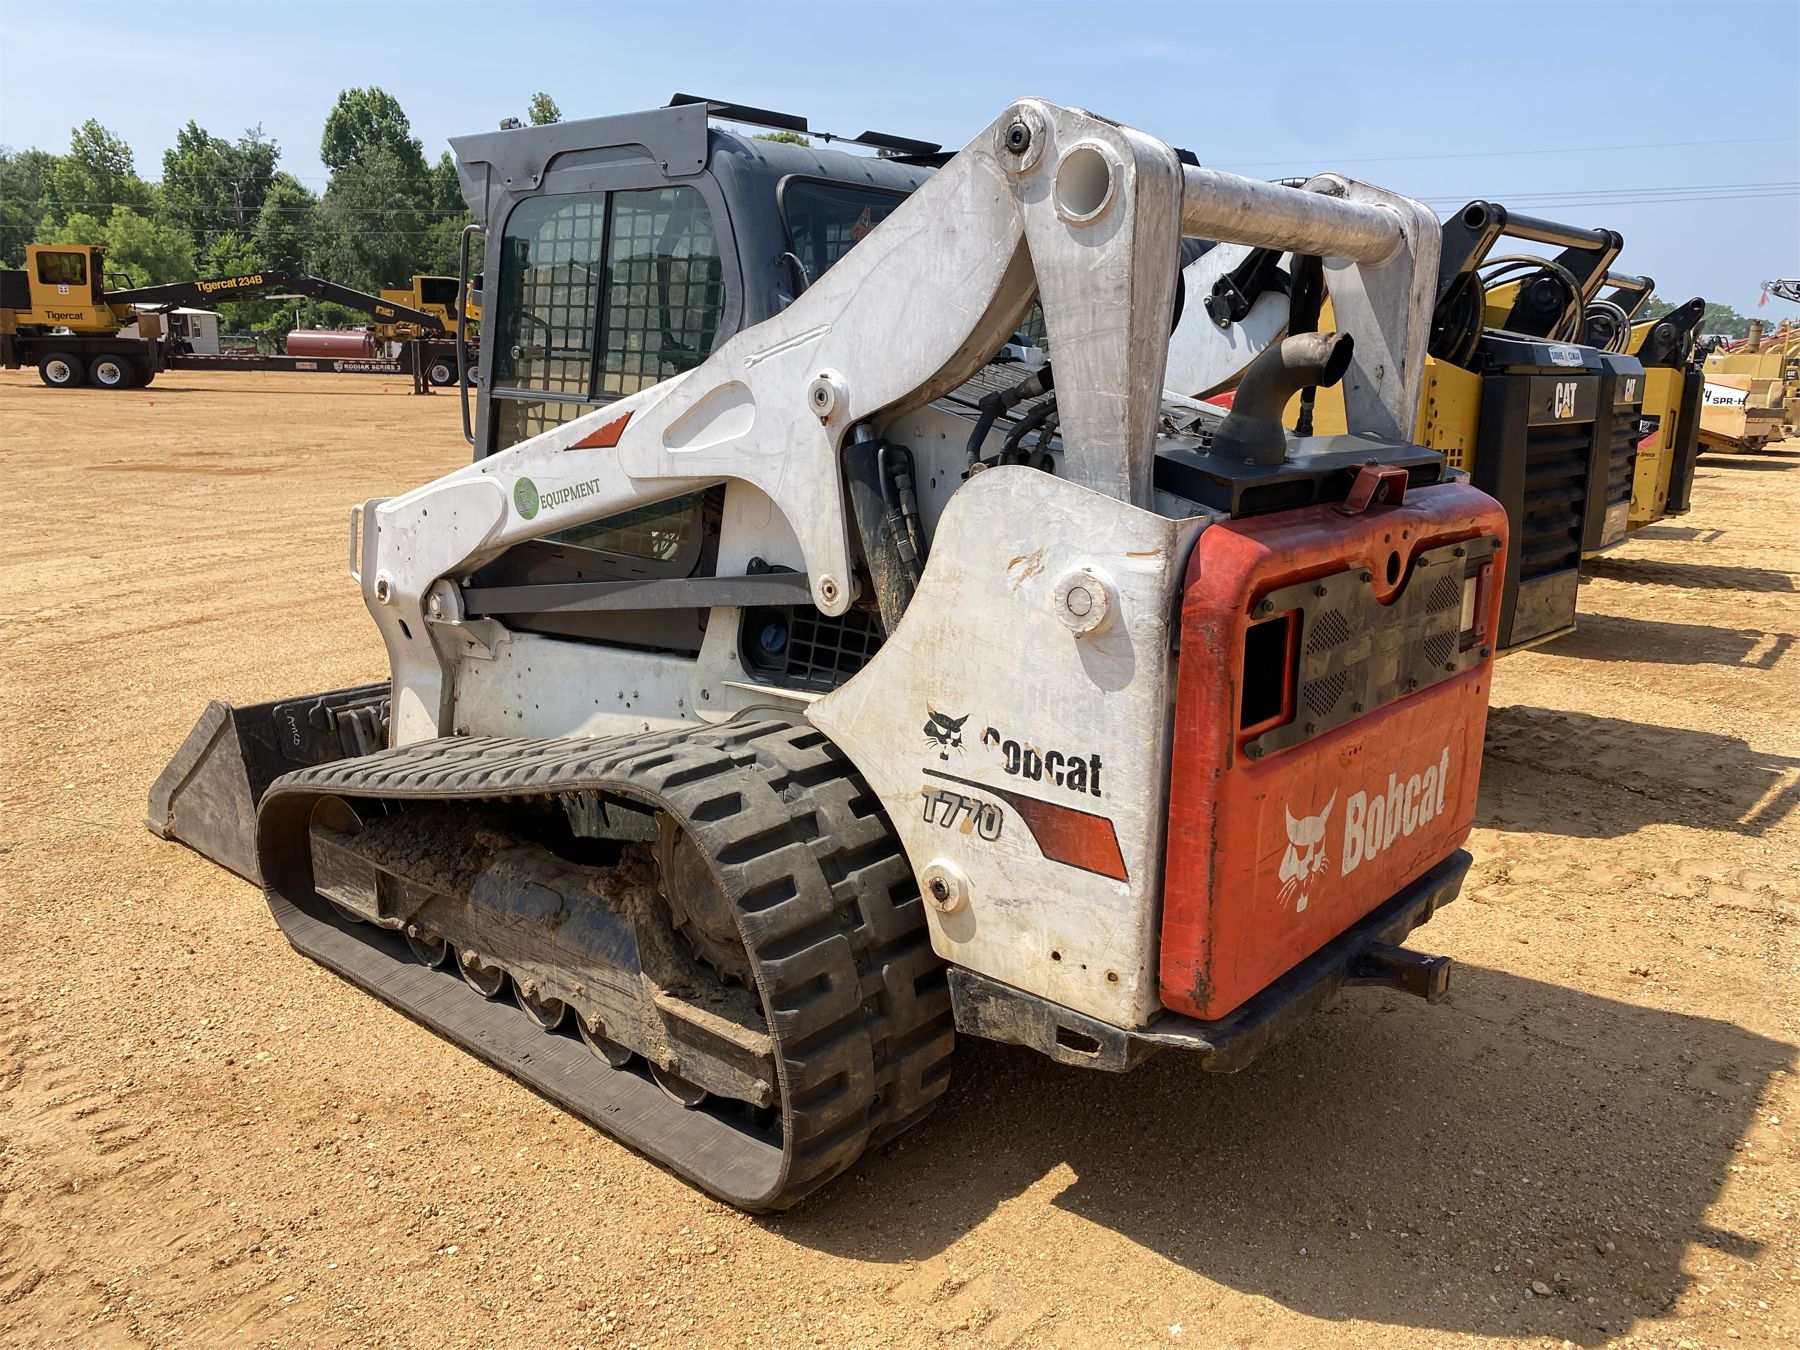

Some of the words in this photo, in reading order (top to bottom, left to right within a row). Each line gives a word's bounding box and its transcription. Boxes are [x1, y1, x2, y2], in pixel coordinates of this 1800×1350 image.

[195, 279, 237, 293] Tigercat
[238, 275, 263, 287] 234B
[45, 310, 83, 321] Tigercat
[1554, 382, 1577, 418] CAT
[540, 478, 600, 509] EQUIPMENT
[922, 784, 1004, 842] T770
[1341, 746, 1449, 878] Bobcat
